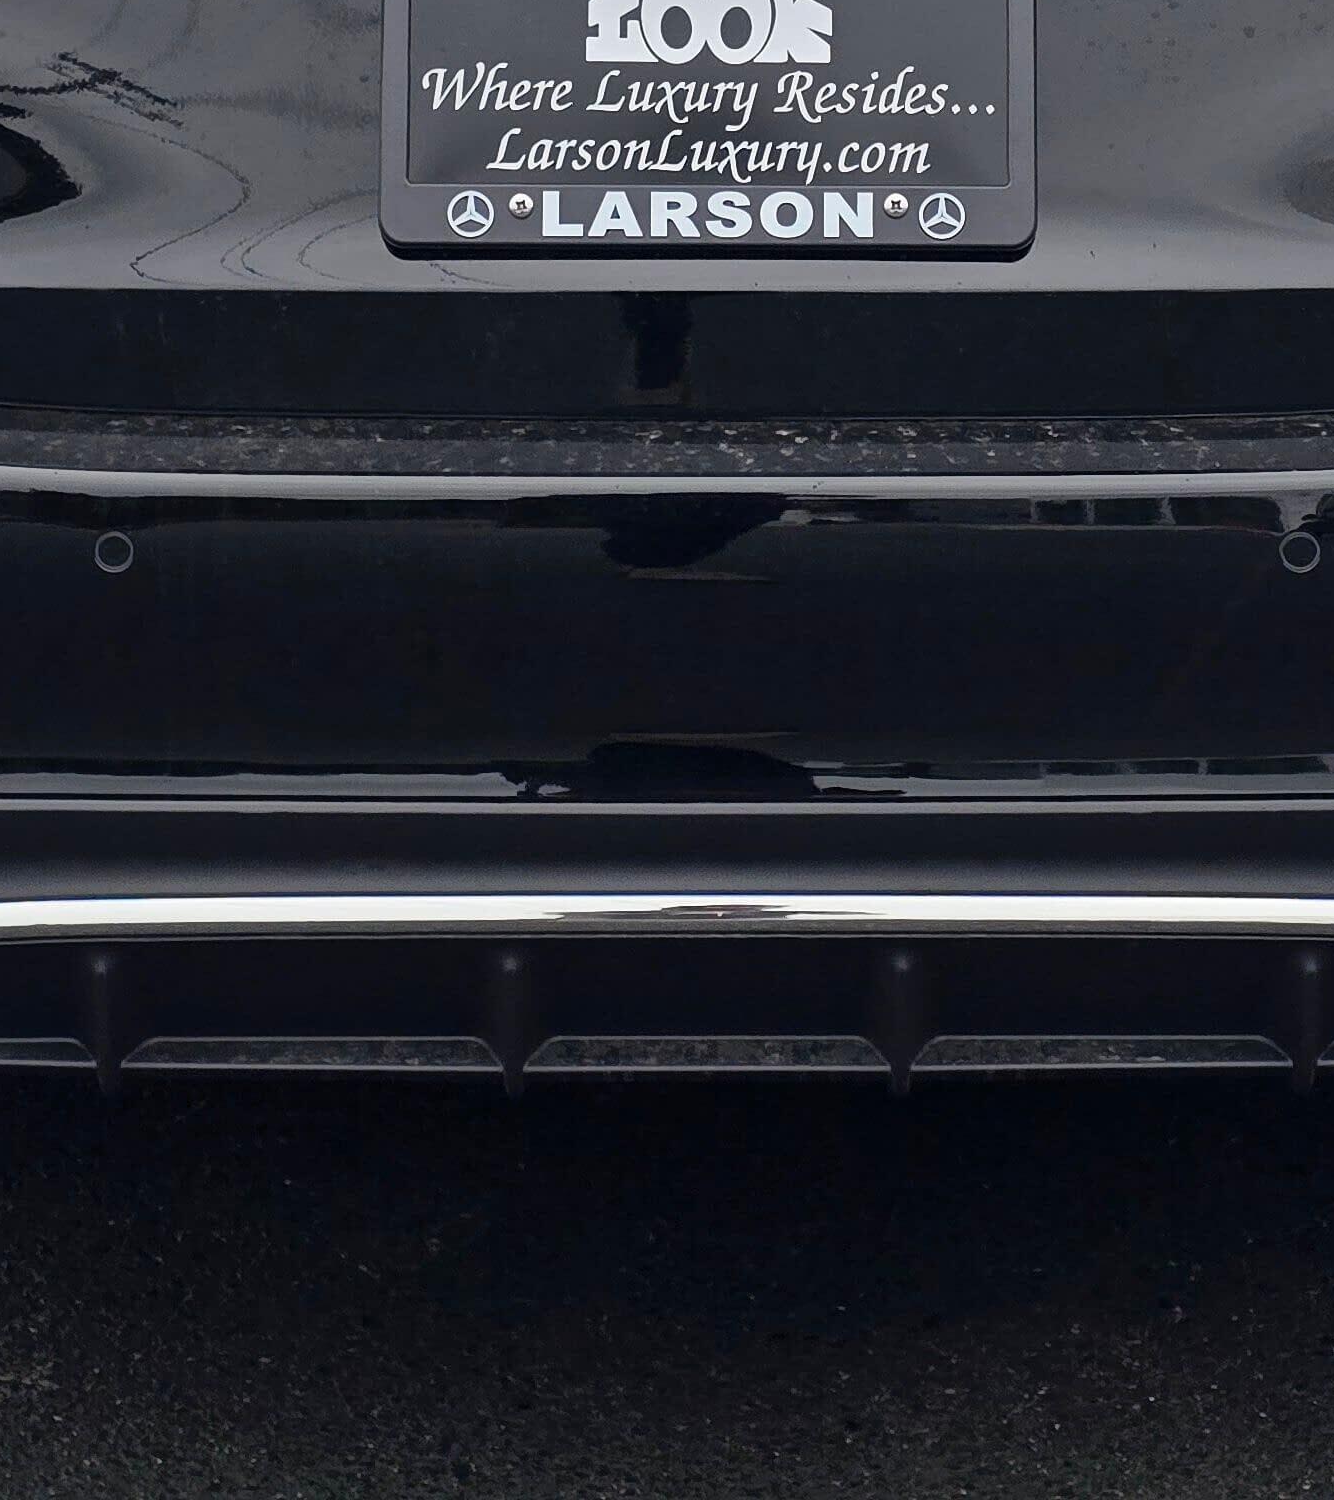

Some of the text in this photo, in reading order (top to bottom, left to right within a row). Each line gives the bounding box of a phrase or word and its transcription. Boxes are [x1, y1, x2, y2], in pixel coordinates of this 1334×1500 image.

[421, 61, 995, 132] Where Luxury Resides...
[485, 127, 931, 186] LarsonLuxury.com
[541, 190, 874, 238] LARSON
